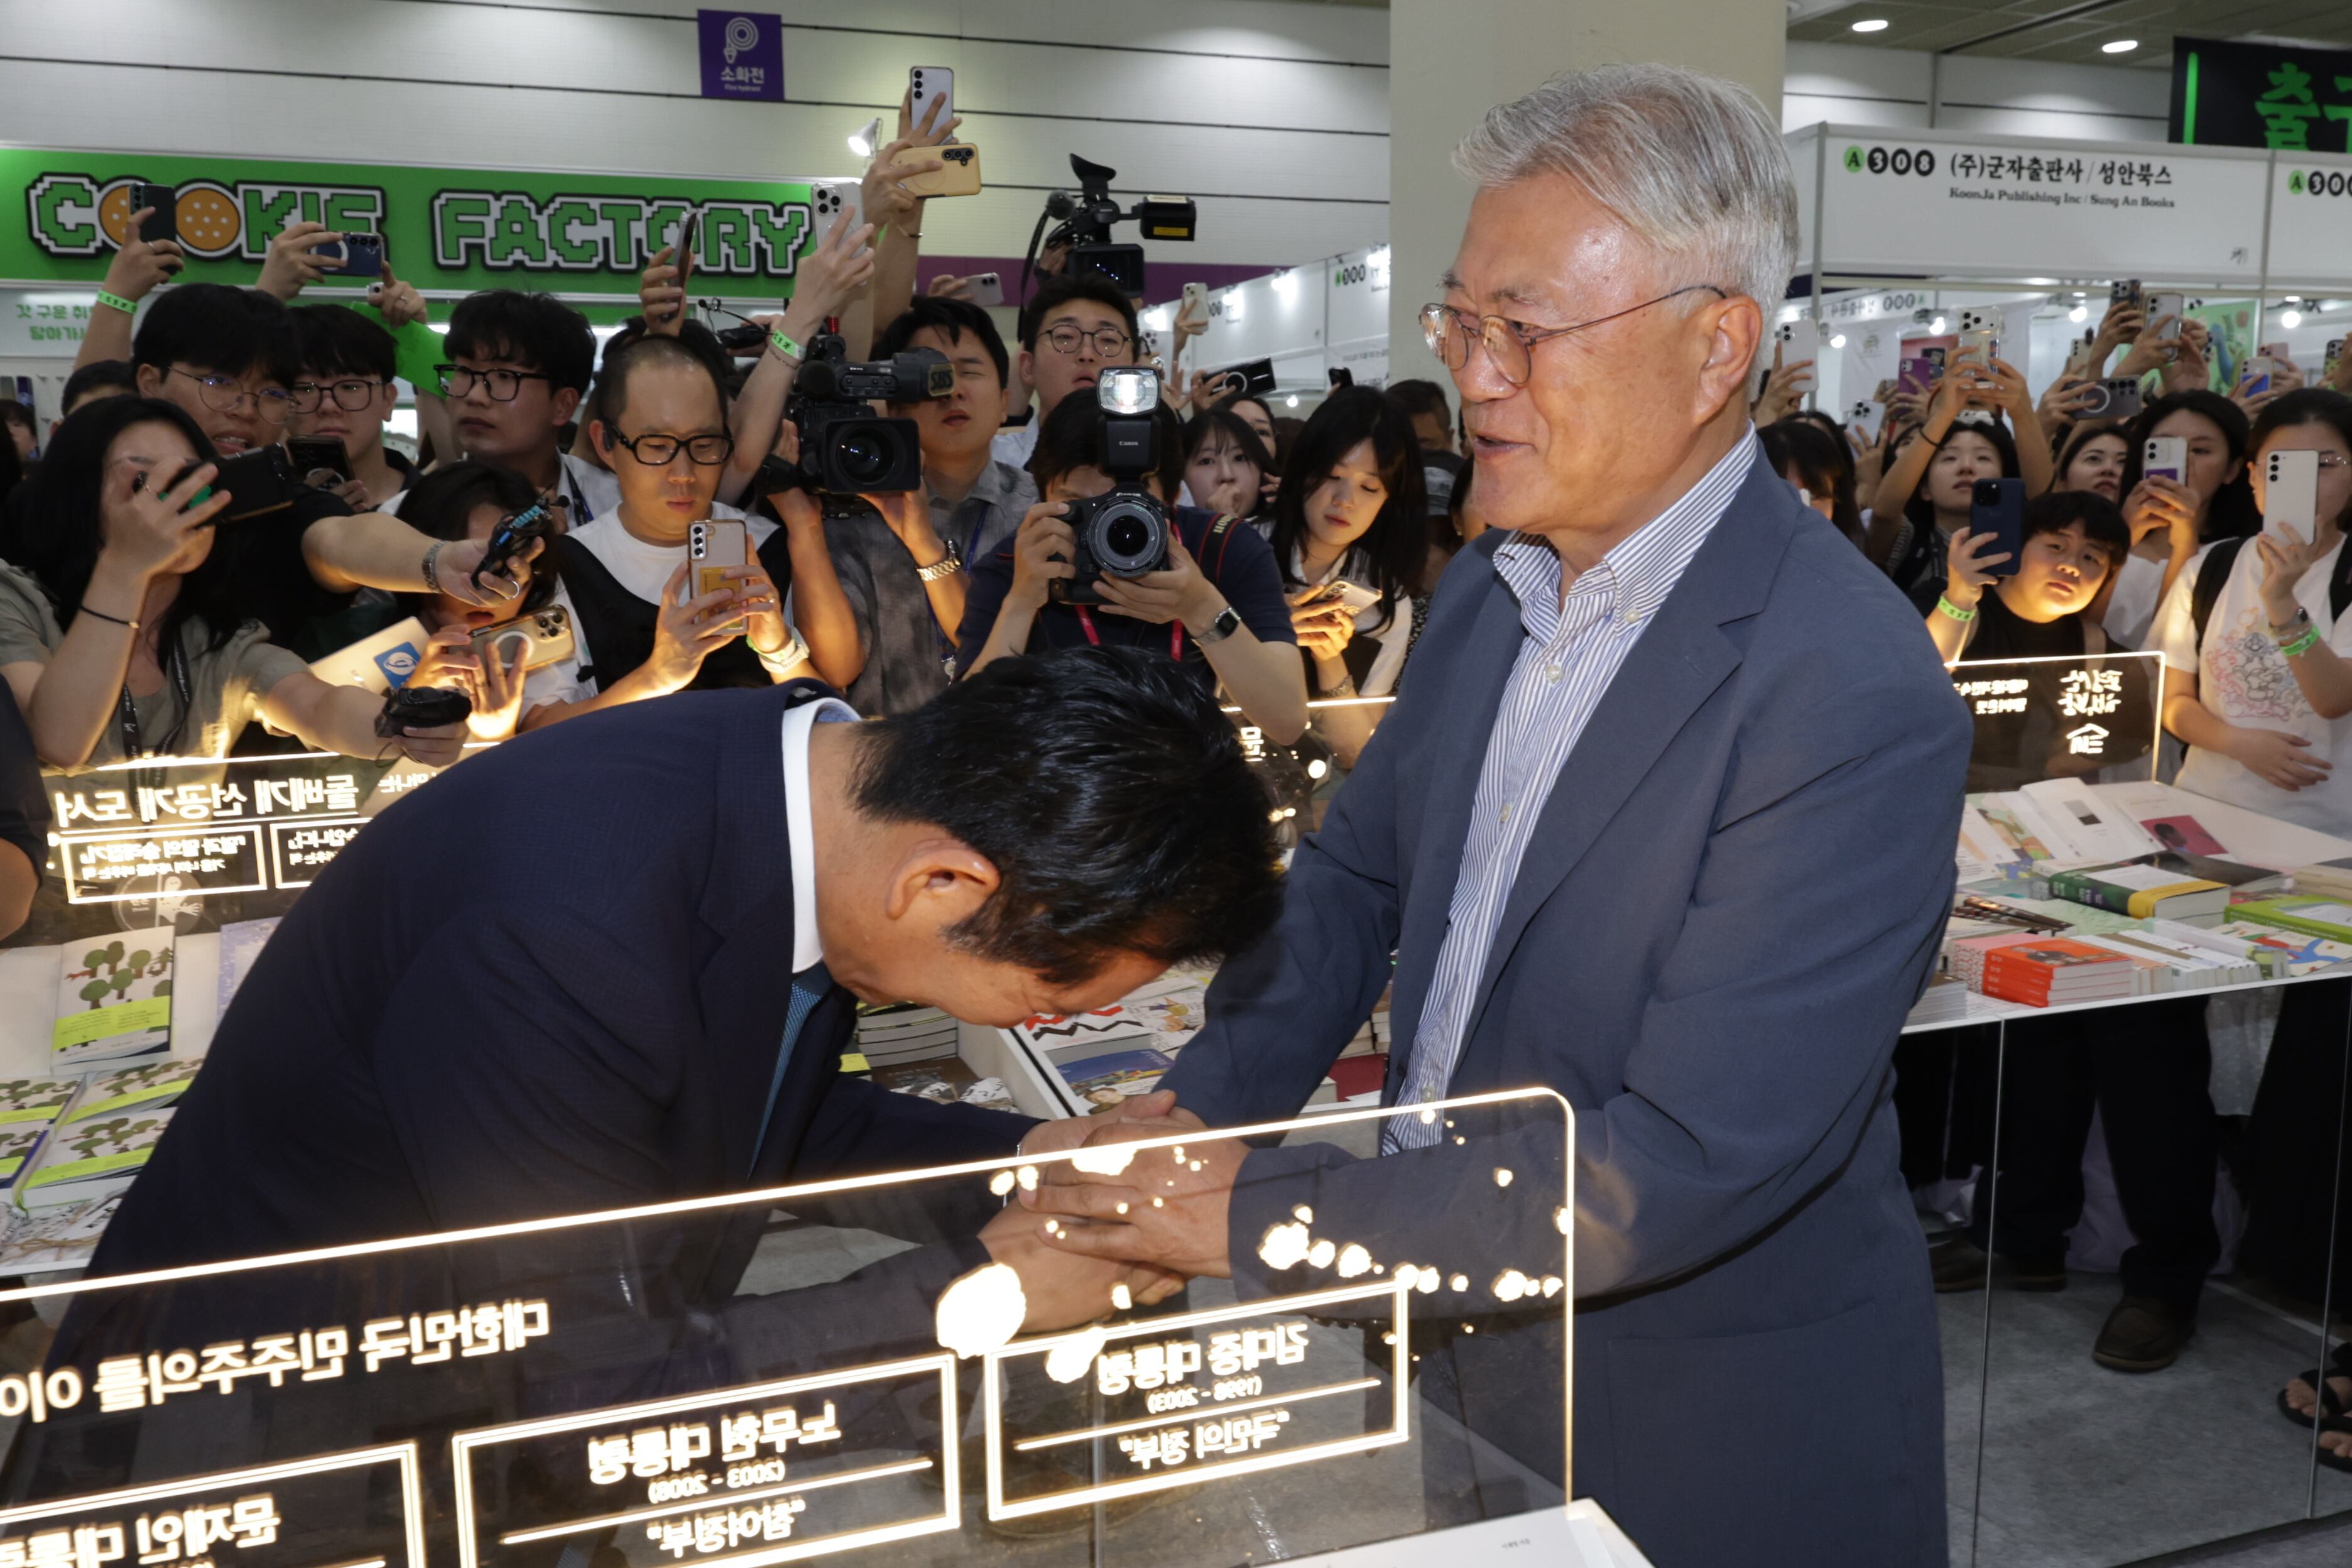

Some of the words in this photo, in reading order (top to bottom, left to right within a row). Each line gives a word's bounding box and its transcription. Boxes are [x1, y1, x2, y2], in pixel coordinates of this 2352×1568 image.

[720, 66, 765, 84] 소화전
[1950, 153, 2083, 184] (주)군자출판사
[2098, 159, 2172, 187] 성안북스
[1949, 187, 1994, 200] KoonJa
[1998, 189, 2061, 206] Publishing
[2064, 192, 2081, 204] Inc
[2090, 194, 2119, 208] Sung
[2121, 196, 2138, 207] An
[2141, 197, 2175, 209] Books
[433, 190, 810, 276] FACTORY
[16, 304, 31, 318] 갓
[37, 305, 67, 319] 구운
[72, 305, 94, 319] 취
